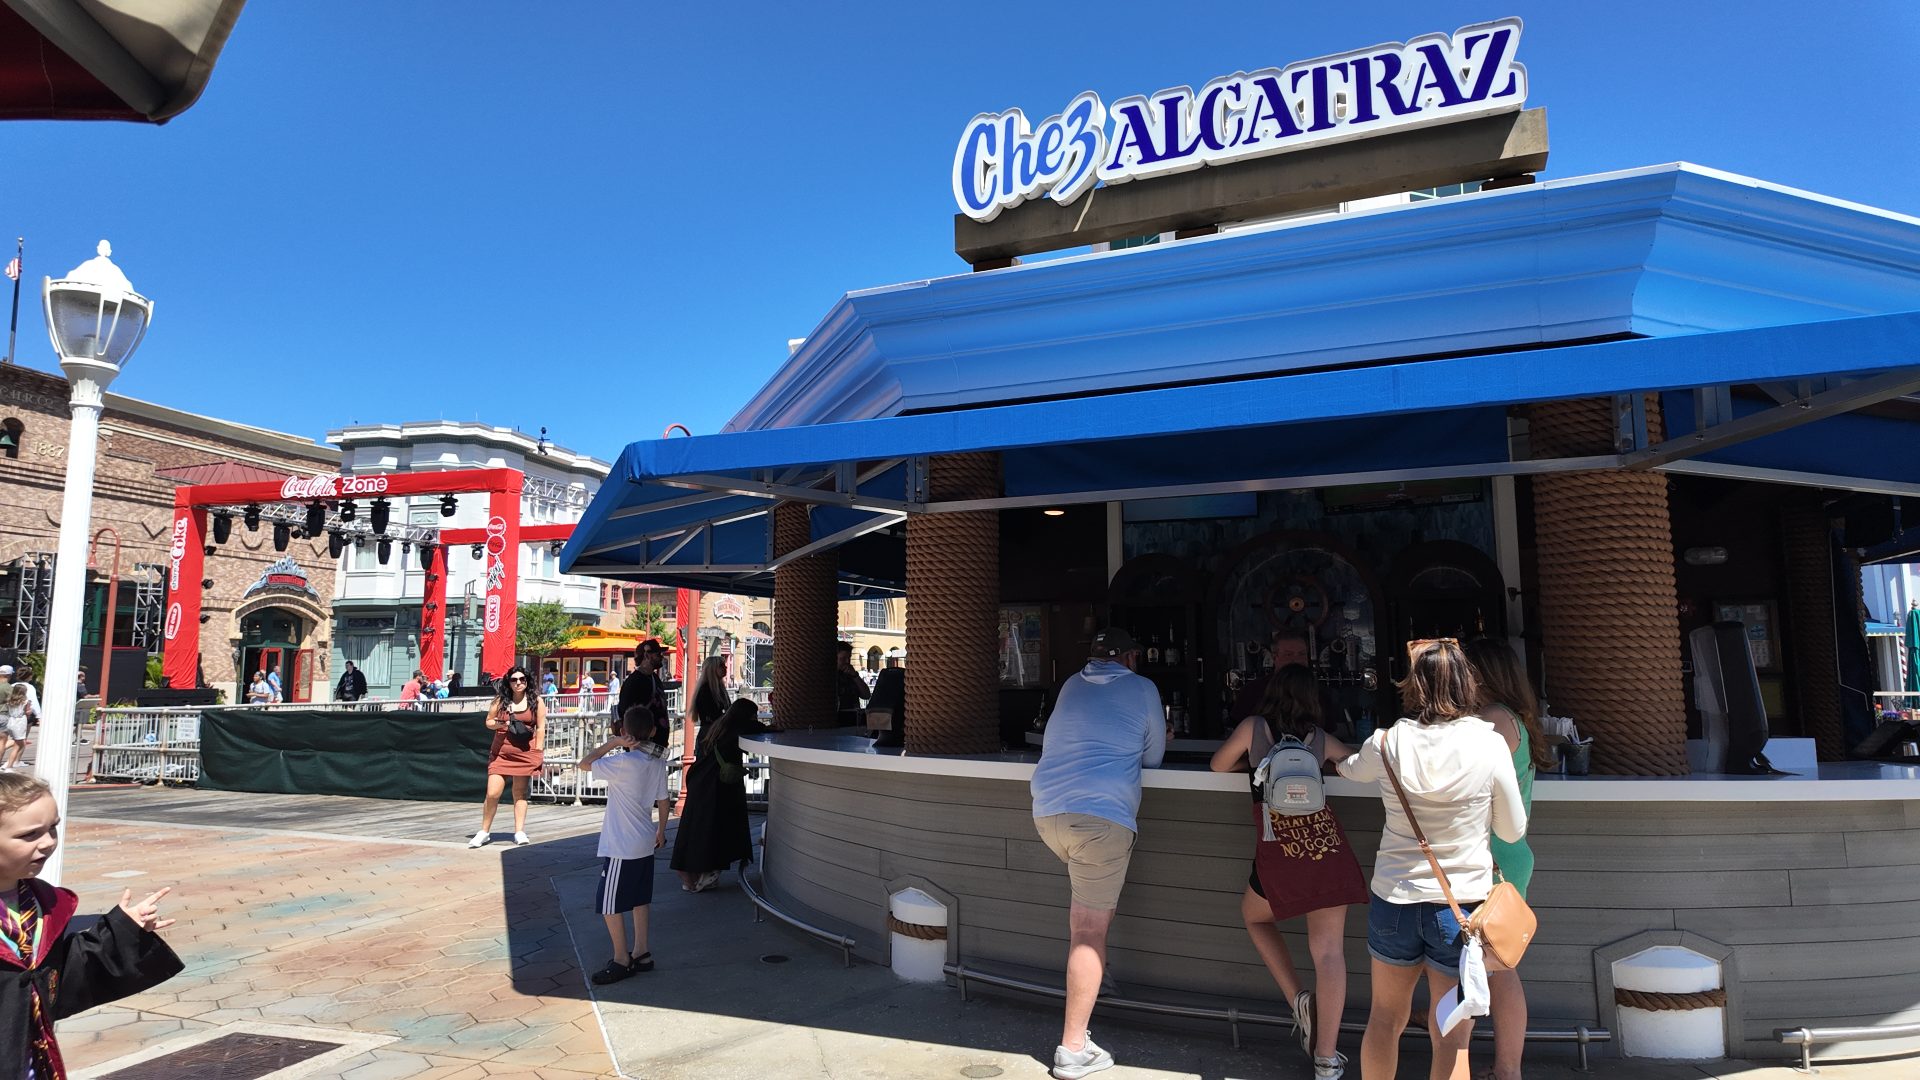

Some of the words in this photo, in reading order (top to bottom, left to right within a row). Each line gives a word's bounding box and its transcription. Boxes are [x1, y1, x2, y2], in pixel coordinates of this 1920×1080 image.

[961, 97, 1098, 211] Chez
[1106, 28, 1517, 171] ALCATRAZ
[32, 441, 64, 458] 1887
[343, 478, 387, 492] Zone
[171, 521, 186, 560] Coke
[488, 597, 498, 629] COKE
[1275, 817, 1305, 831] THAT
[1306, 816, 1312, 825] I
[1314, 811, 1331, 822] AM
[1290, 827, 1310, 840] UP
[1313, 822, 1330, 836] TO
[1280, 842, 1301, 858] NO
[1305, 833, 1341, 851] GOOD
